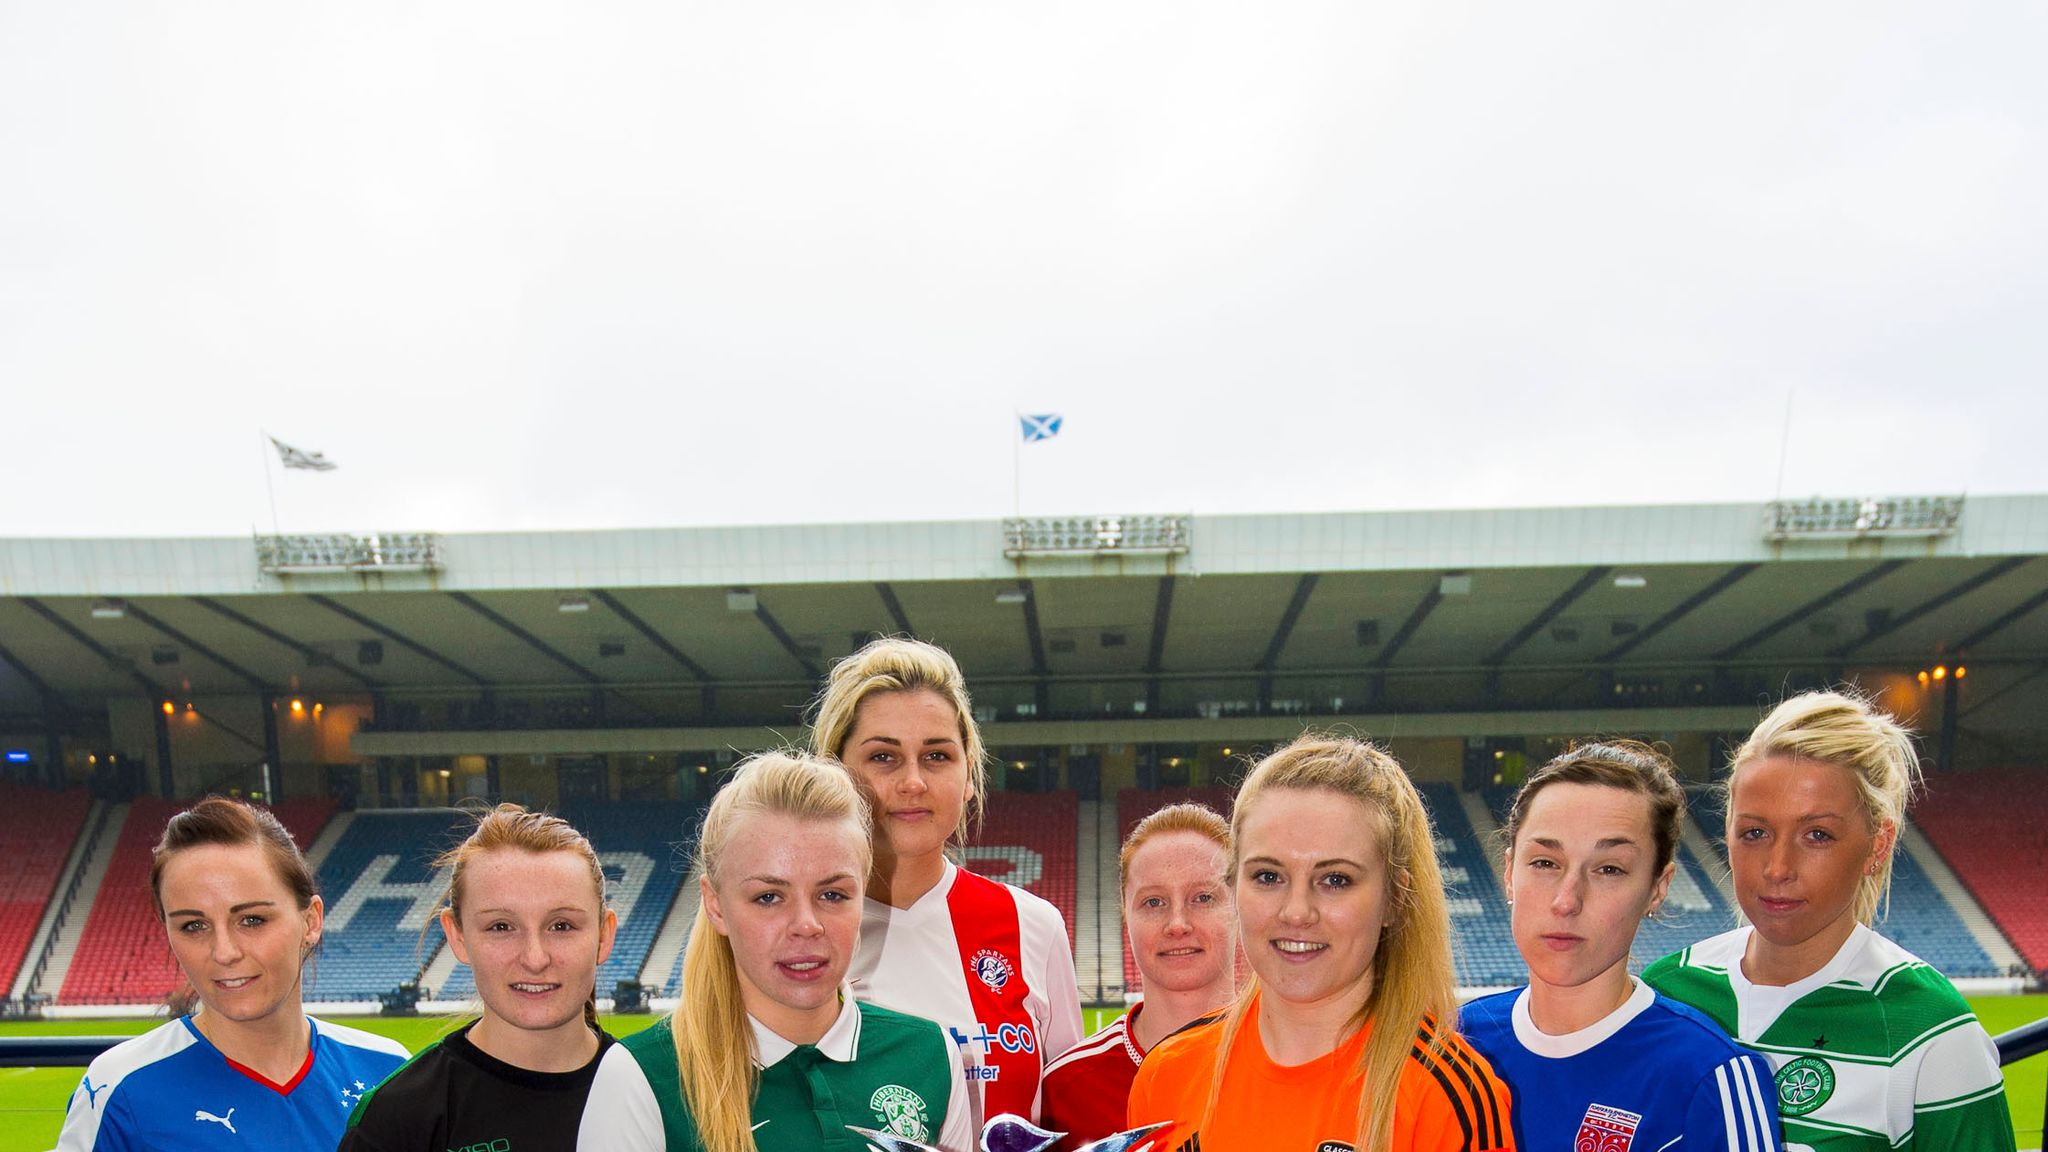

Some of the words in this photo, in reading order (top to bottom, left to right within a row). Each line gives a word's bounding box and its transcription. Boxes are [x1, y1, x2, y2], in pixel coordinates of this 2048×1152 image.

[970, 955, 979, 972] THE
[977, 949, 1015, 977] SPARTANS
[1782, 1060, 1803, 1075] CELTIC
[1803, 1059, 1829, 1076] FOOTBALL
[1822, 1075, 1832, 1091] CLUB
[872, 1087, 922, 1108] HIBERNIAN
